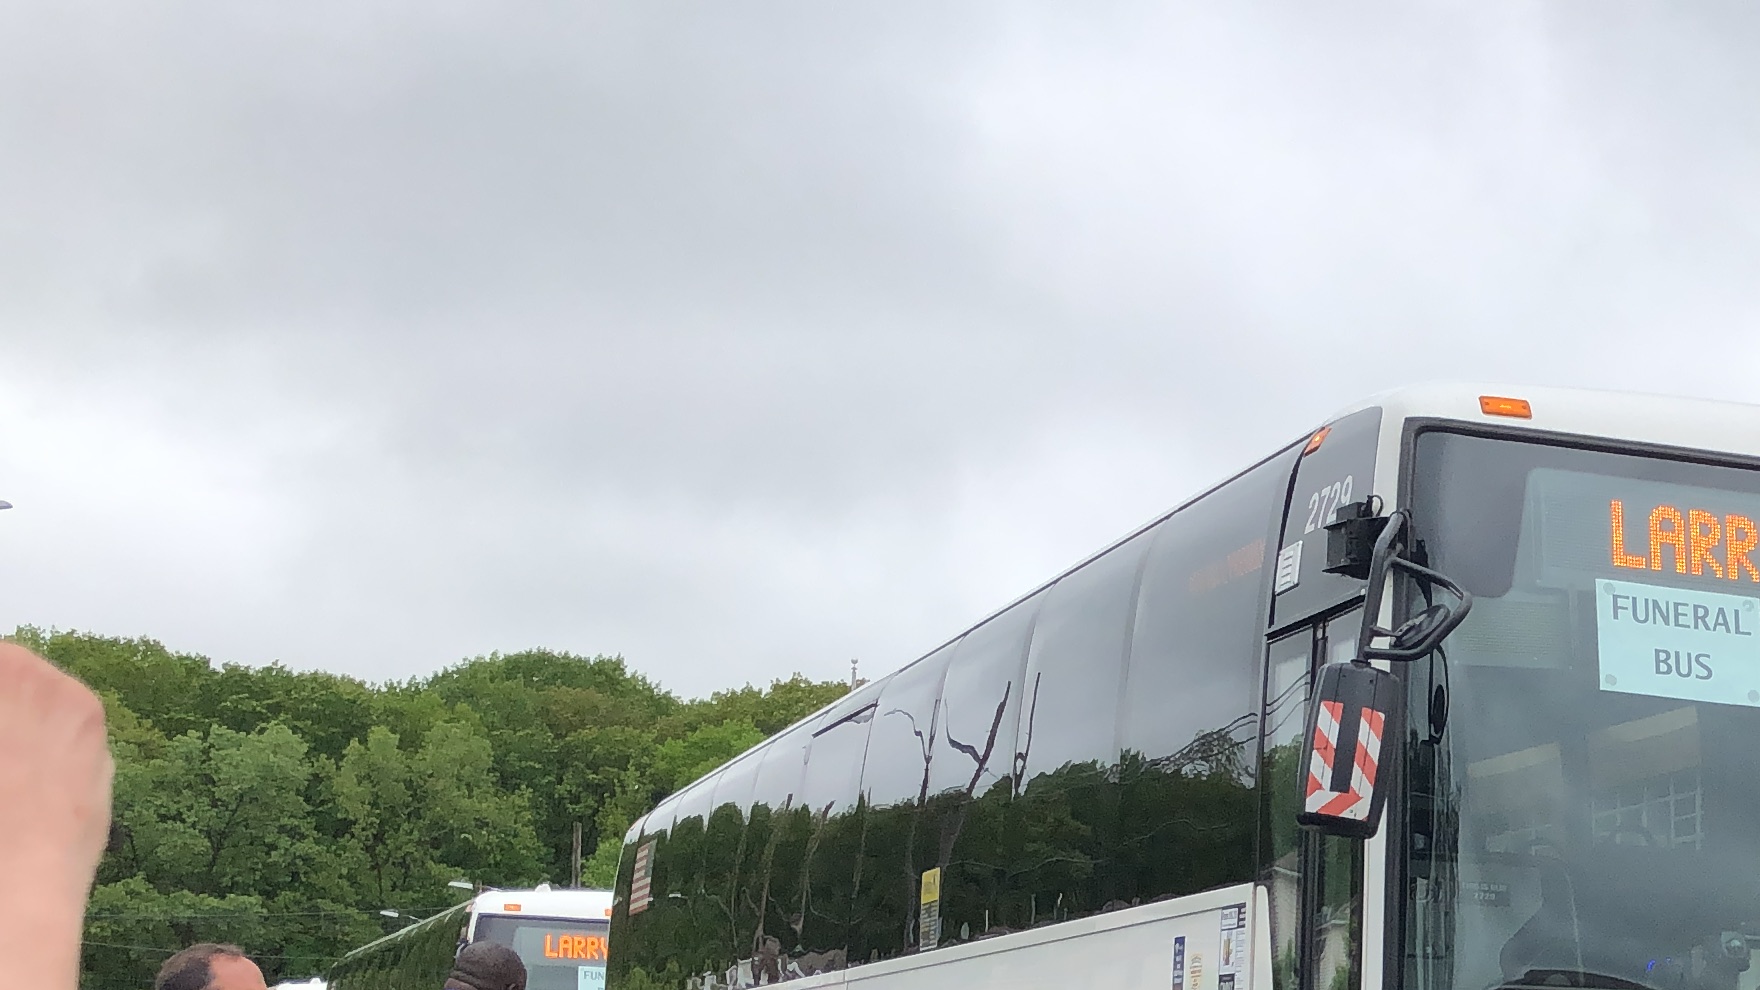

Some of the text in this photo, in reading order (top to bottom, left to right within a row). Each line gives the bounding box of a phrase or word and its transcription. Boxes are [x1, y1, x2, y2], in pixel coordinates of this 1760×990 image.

[1612, 594, 1752, 636] FUNERAL
[1654, 648, 1713, 681] BUS
[544, 933, 608, 960] LARRY
